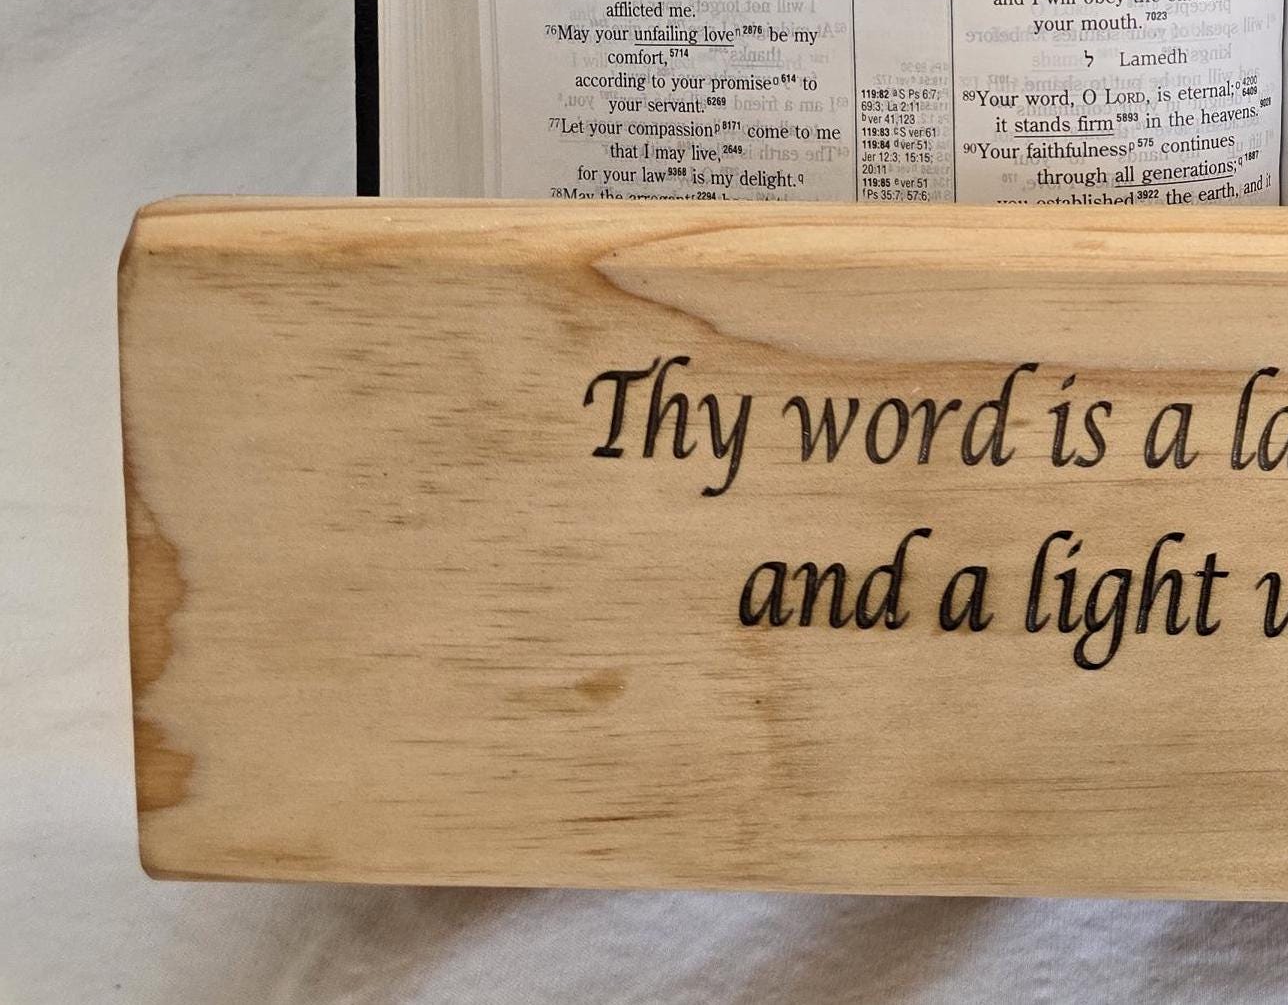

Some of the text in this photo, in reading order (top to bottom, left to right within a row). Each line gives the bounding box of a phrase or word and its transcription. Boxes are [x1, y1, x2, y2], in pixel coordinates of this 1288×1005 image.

[607, 1, 695, 17] afflicted me.
[1033, 12, 1143, 35] your mouth.
[1119, 47, 1188, 67] Lamedh
[747, 124, 841, 141] come to me
[862, 164, 887, 175] 20:11
[583, 356, 752, 497] Thy
[783, 363, 1039, 466] word
[1048, 374, 1112, 467] is
[1144, 403, 1199, 469] a
[739, 528, 932, 630] and
[939, 566, 993, 632] a
[1025, 531, 1229, 670] light
